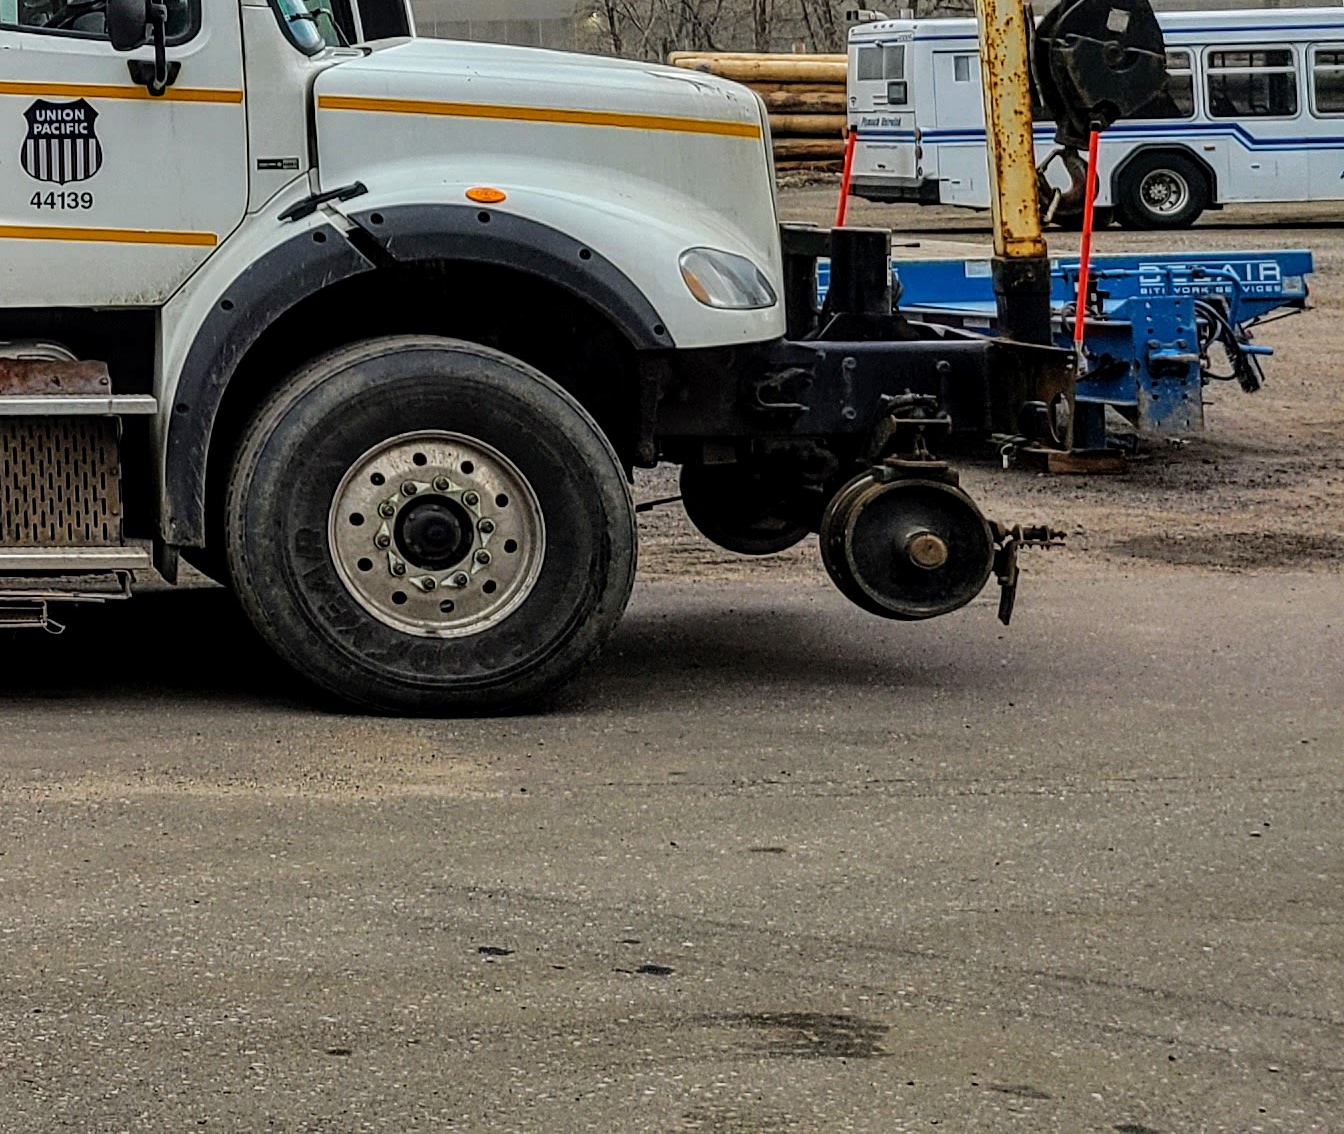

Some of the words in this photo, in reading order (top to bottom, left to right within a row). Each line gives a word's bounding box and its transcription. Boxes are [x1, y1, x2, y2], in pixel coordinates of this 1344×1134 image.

[35, 108, 85, 121] UNION
[33, 122, 89, 135] PACIFIC
[30, 191, 94, 210] 44139
